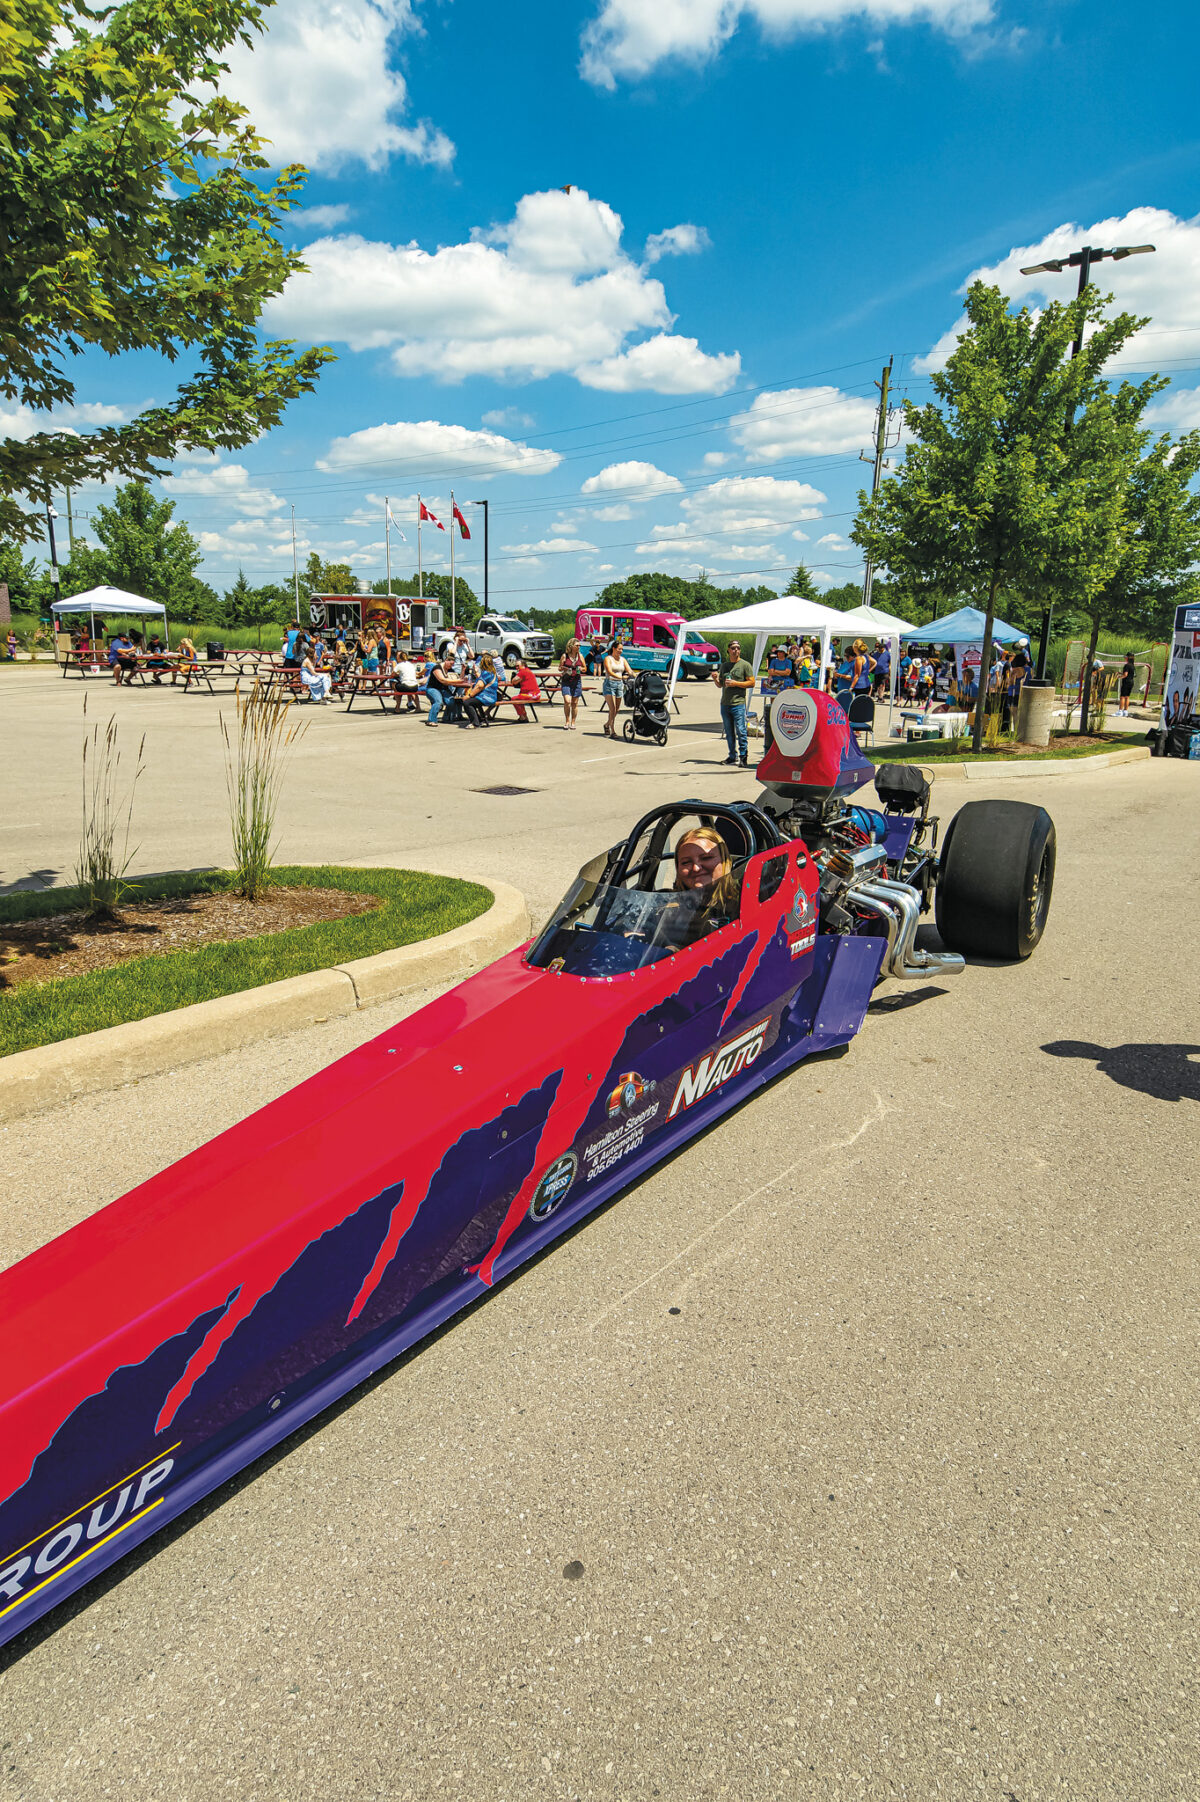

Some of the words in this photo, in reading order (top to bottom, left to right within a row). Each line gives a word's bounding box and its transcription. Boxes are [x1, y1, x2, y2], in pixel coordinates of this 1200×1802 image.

[583, 1126, 624, 1161] Hamilton
[624, 1101, 660, 1132] Steering
[599, 1126, 644, 1162] Automotive
